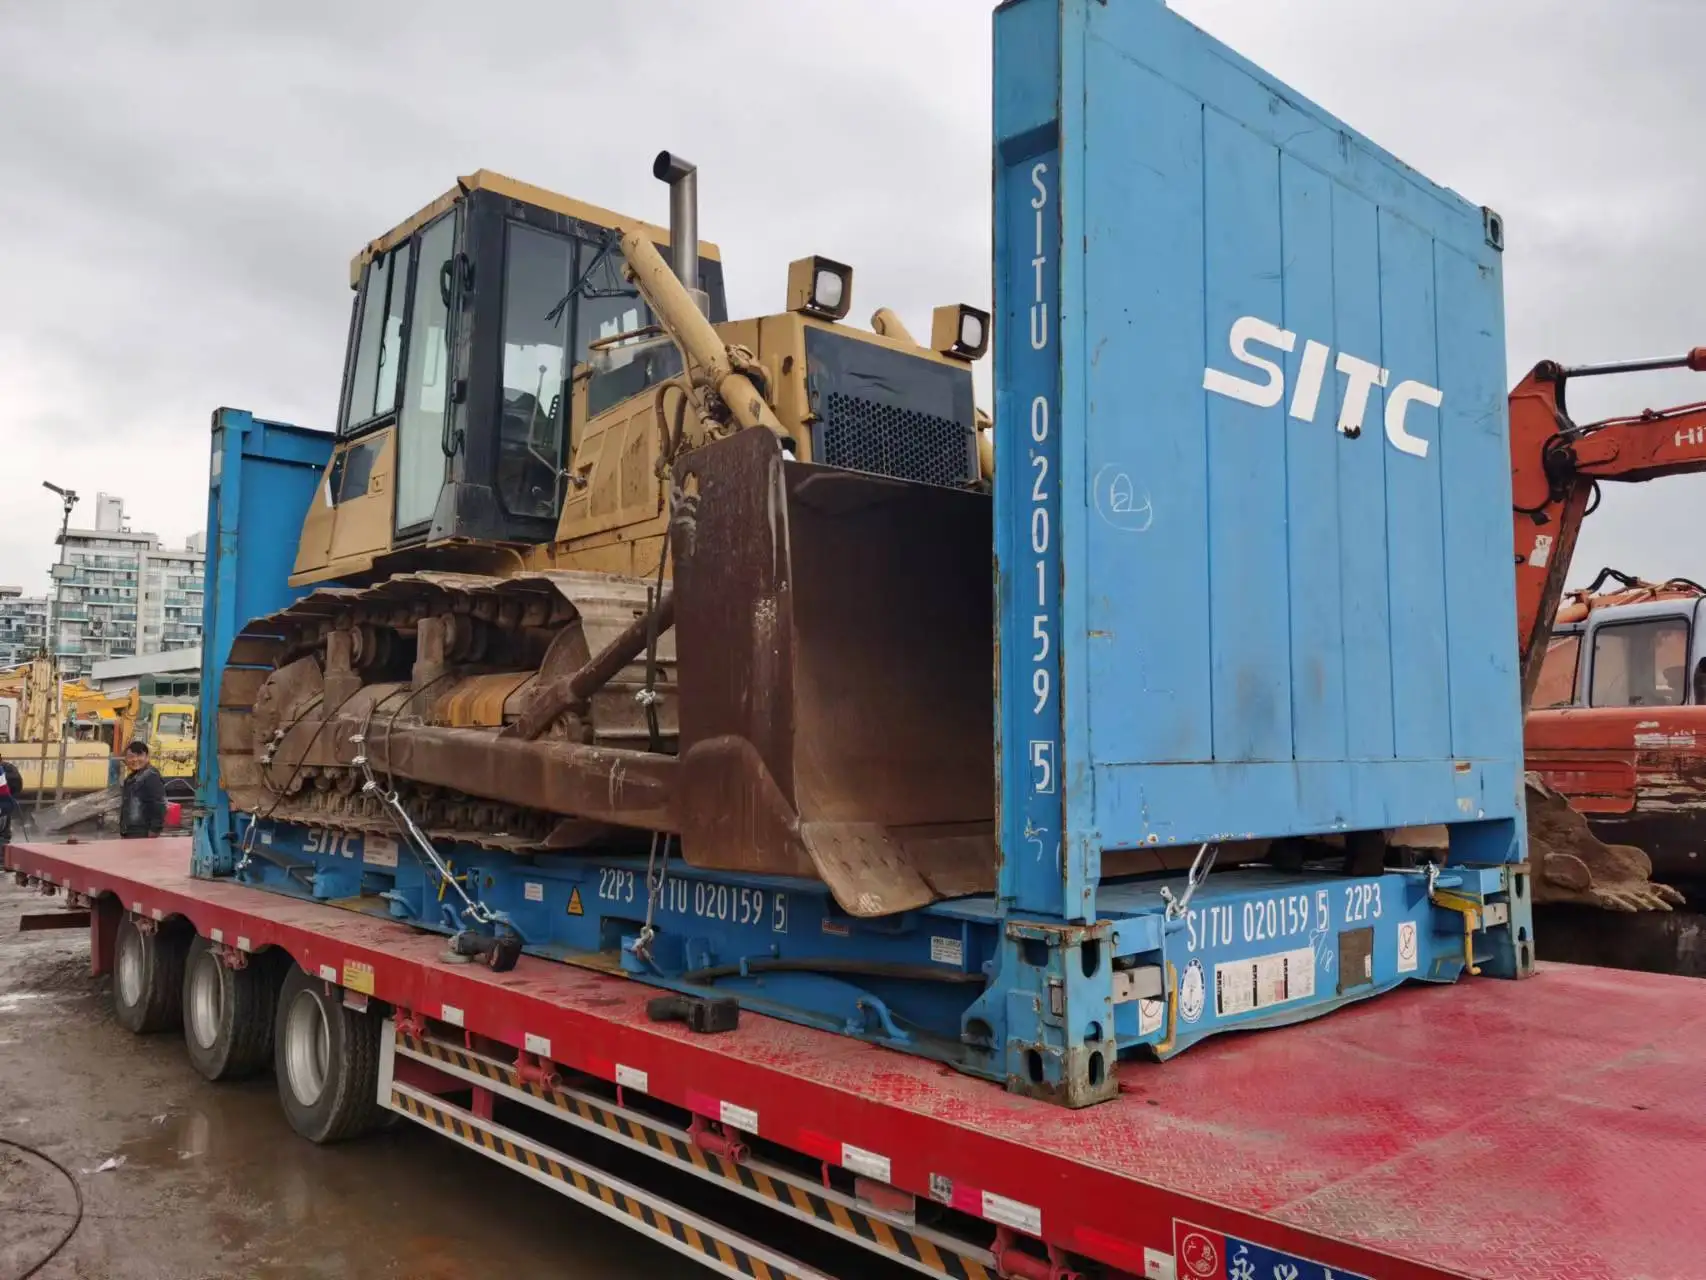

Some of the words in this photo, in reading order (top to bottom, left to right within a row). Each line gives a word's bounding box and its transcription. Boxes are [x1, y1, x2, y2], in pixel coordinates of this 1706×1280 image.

[1030, 162, 1048, 350] SITU
[1202, 315, 1444, 458] SITC
[1031, 395, 1050, 715] 020159
[1032, 742, 1052, 792] 5
[303, 828, 361, 859] SITC
[599, 867, 634, 903] 22P3
[694, 882, 764, 925] 020159
[773, 892, 786, 931] 5
[1186, 904, 1233, 952] SITU
[1243, 895, 1309, 942] 020159
[1316, 891, 1328, 931] 5
[1344, 883, 1382, 923] 22P3
